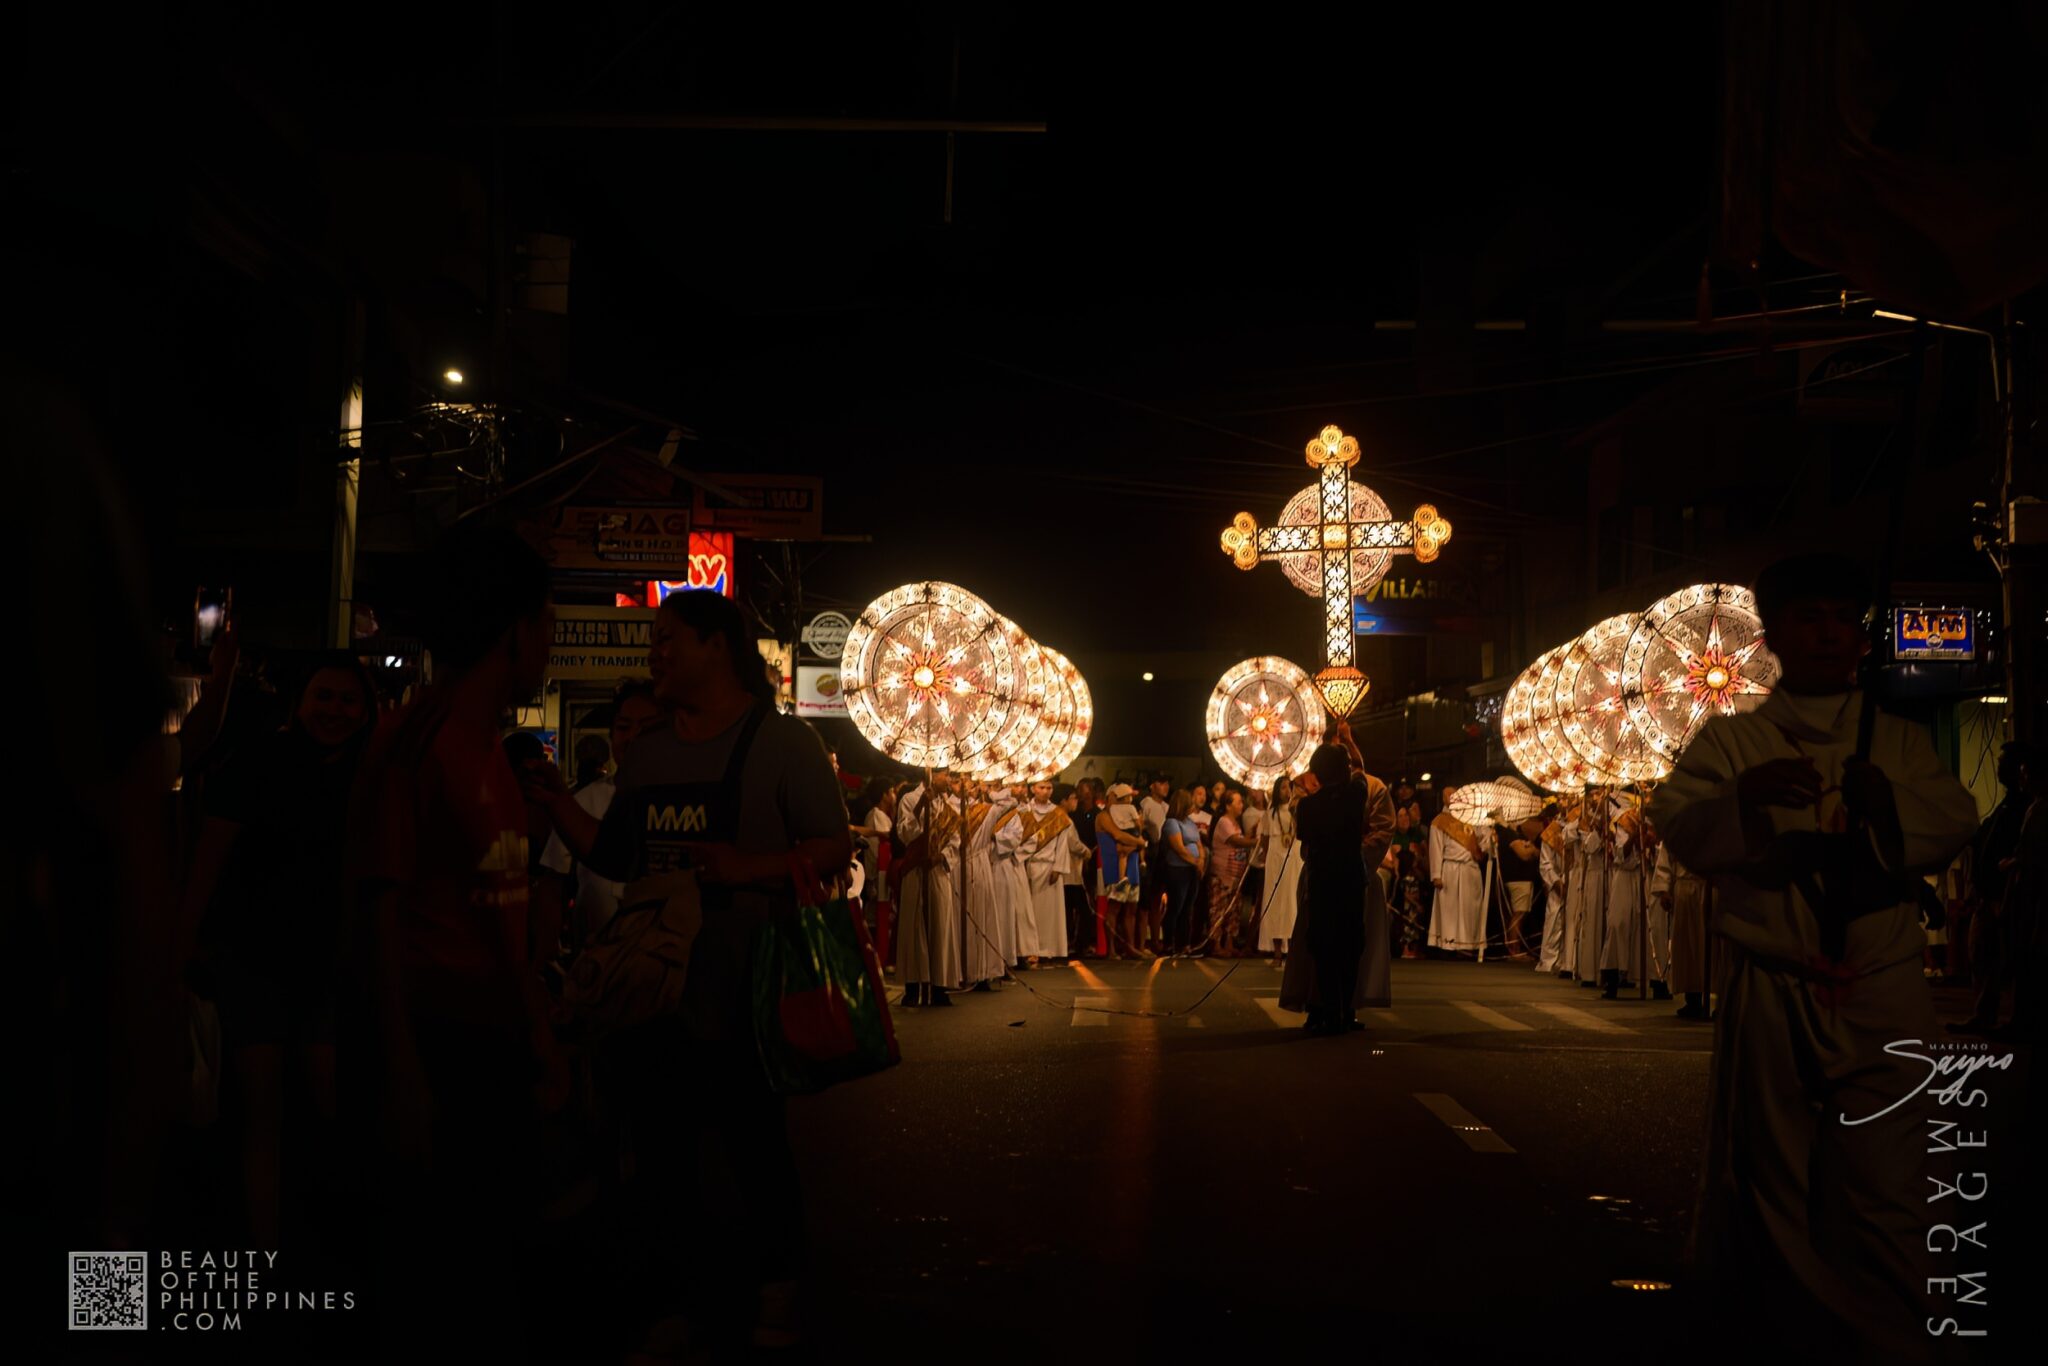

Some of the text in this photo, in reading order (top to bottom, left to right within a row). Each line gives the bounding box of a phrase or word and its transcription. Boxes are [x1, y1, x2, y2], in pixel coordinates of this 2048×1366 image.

[1907, 613, 1965, 633] ATM
[554, 633, 609, 645] UNION
[550, 655, 586, 667] ONEY
